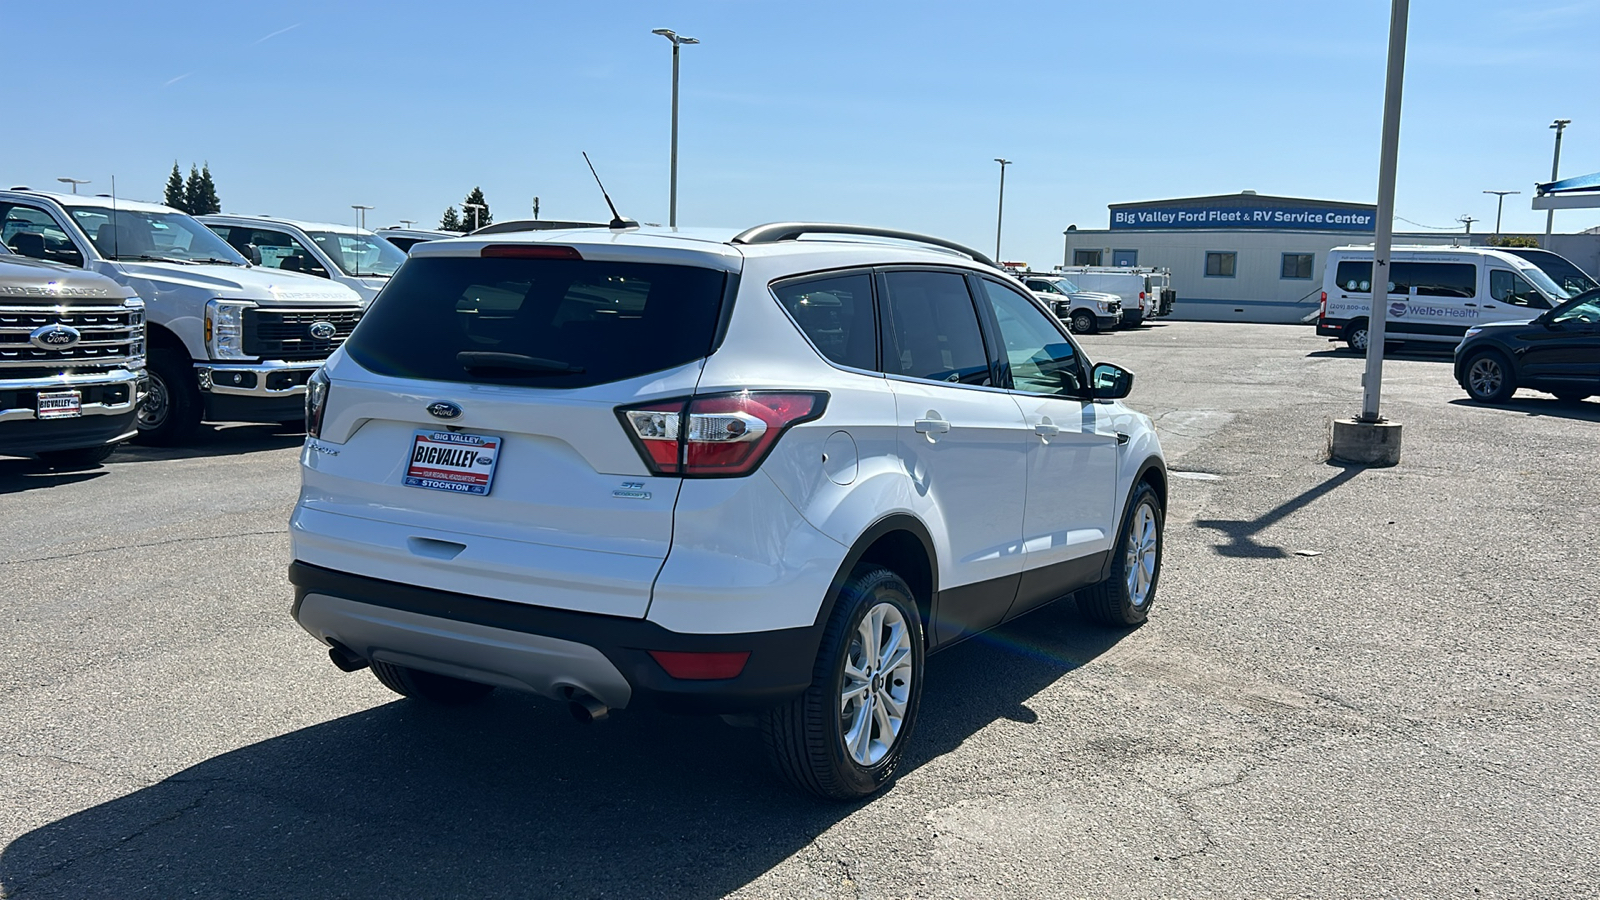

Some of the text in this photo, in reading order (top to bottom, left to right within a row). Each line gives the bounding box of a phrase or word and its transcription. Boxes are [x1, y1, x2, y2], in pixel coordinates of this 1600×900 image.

[1115, 210, 1371, 225] Big Valley Ford Fleet & RV Service Center
[47, 332, 70, 343] Ford
[40, 399, 71, 408] BIGVALLEY
[432, 404, 454, 417] Ford
[434, 433, 480, 444] BIG VALLEY
[414, 446, 478, 468] BIGVALLEY
[421, 480, 469, 492] STOCKTON
